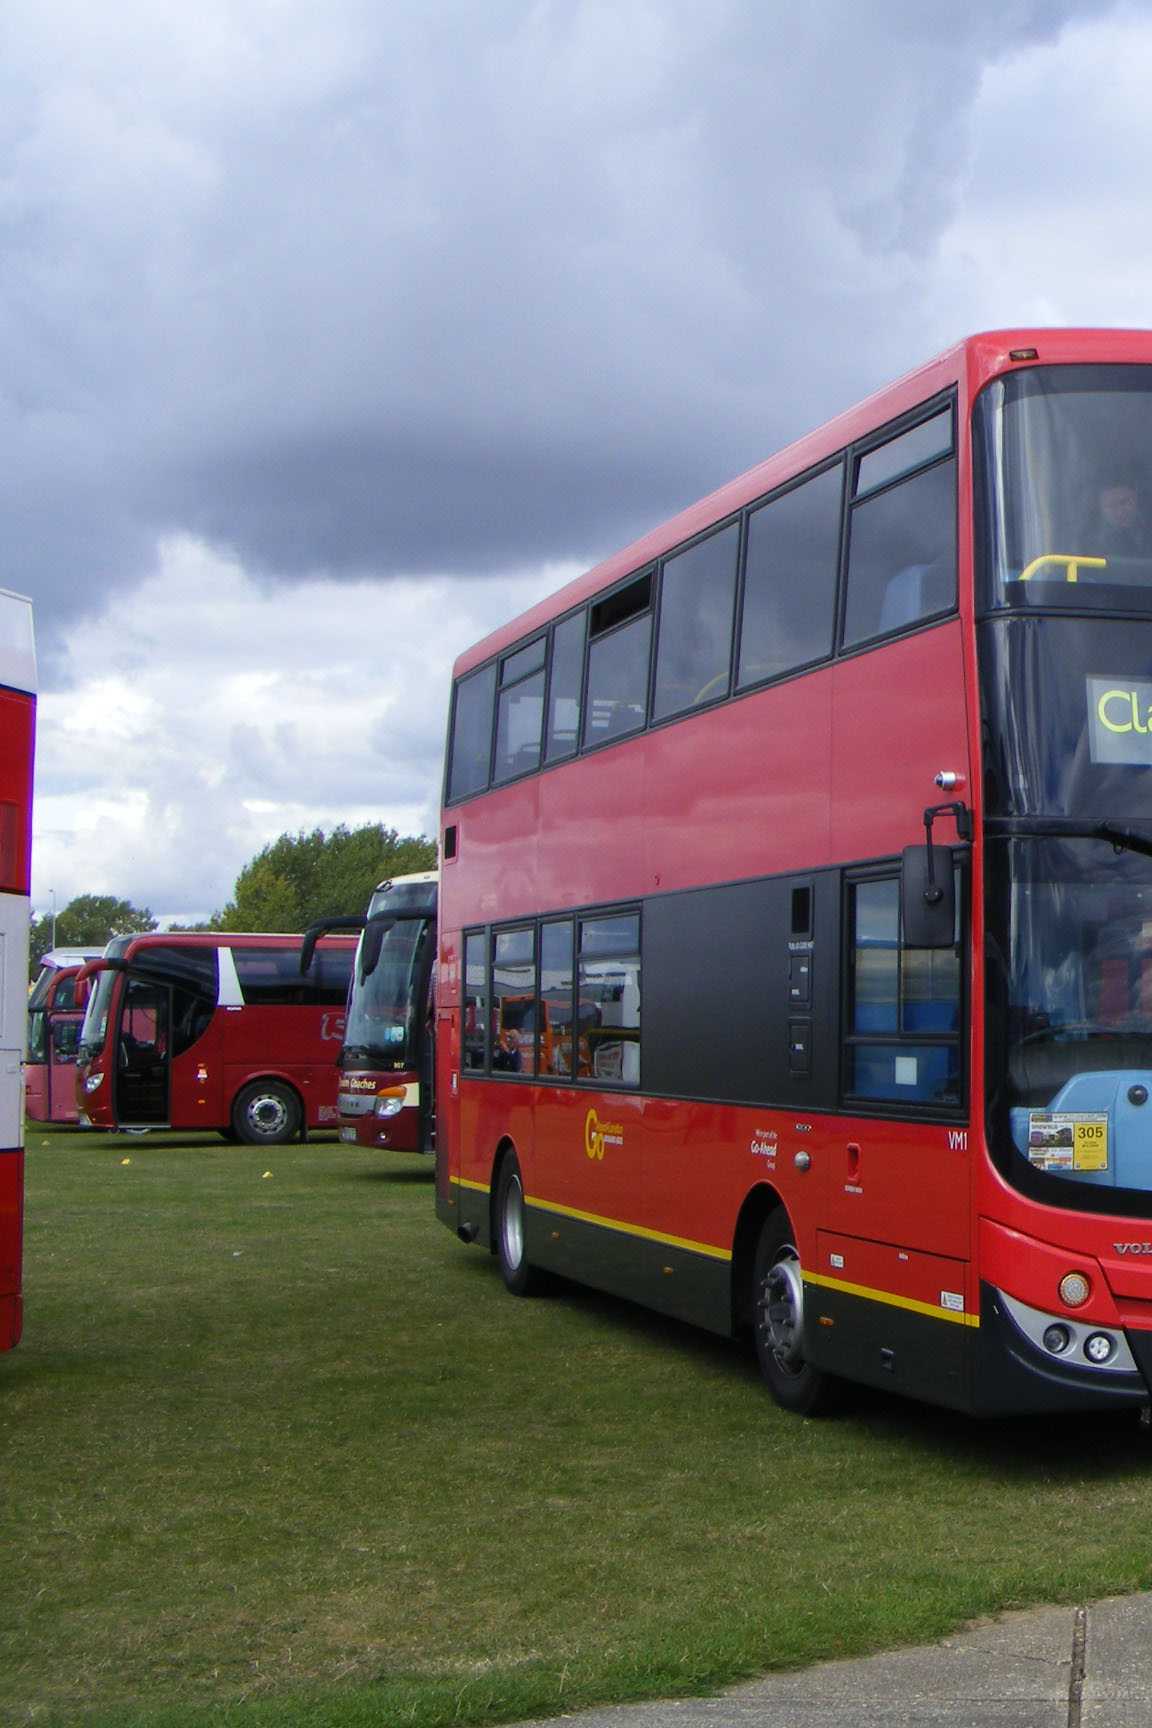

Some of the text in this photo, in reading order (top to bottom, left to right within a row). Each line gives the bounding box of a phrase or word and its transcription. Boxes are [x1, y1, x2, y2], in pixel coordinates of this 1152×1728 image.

[350, 1078, 377, 1090] Coaches
[1078, 1126, 1103, 1138] 305
[948, 1131, 968, 1150] VM1
[750, 1140, 777, 1156] Go-Ahead
